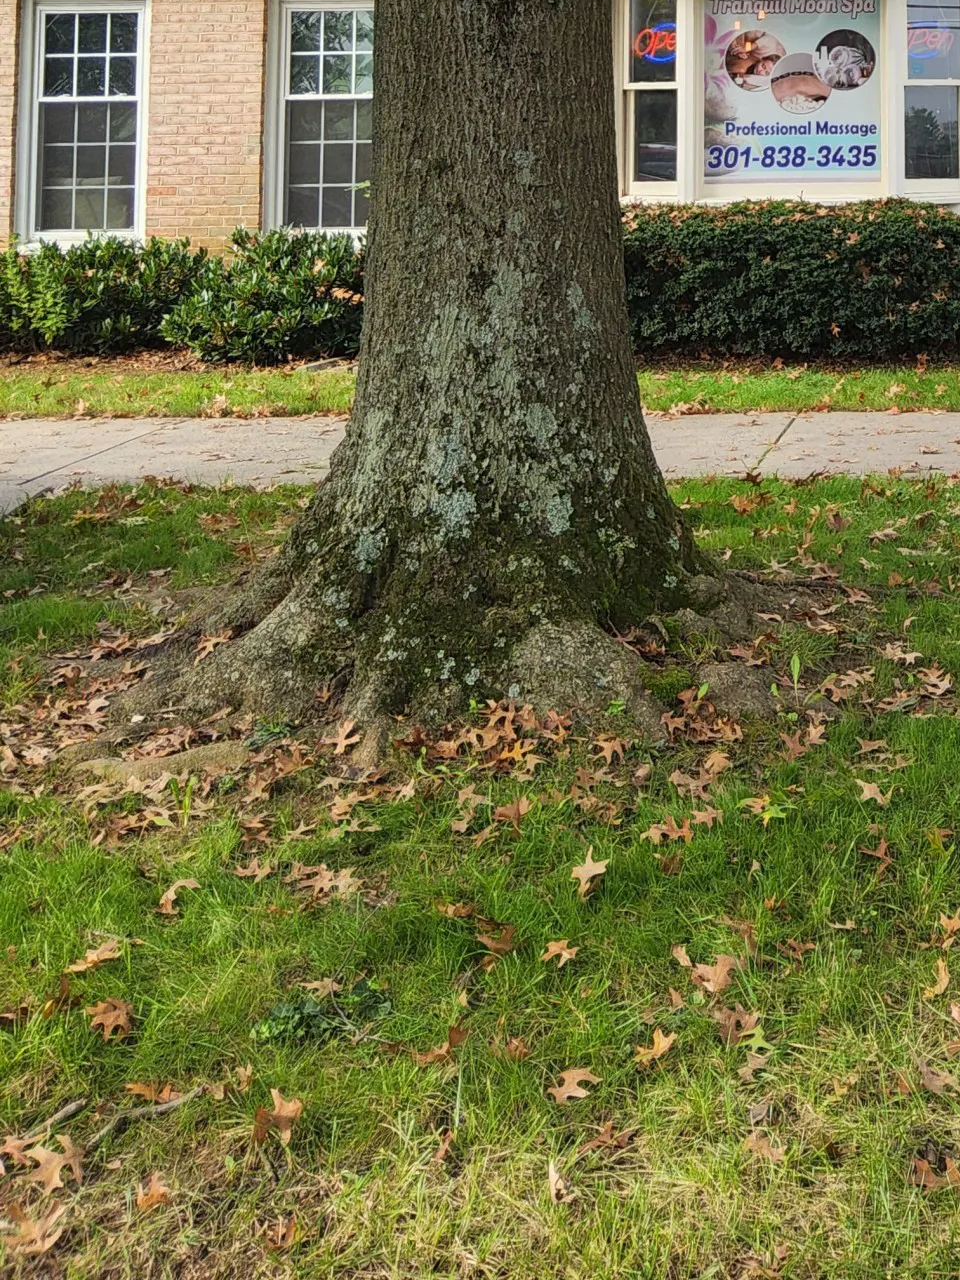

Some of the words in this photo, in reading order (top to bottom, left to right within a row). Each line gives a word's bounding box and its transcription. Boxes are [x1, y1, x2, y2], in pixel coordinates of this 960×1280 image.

[634, 28, 676, 58] Ope
[908, 29, 955, 55] pen
[725, 121, 812, 136] Professional
[815, 121, 877, 137] Massage
[707, 145, 877, 169] 301-838-3435
